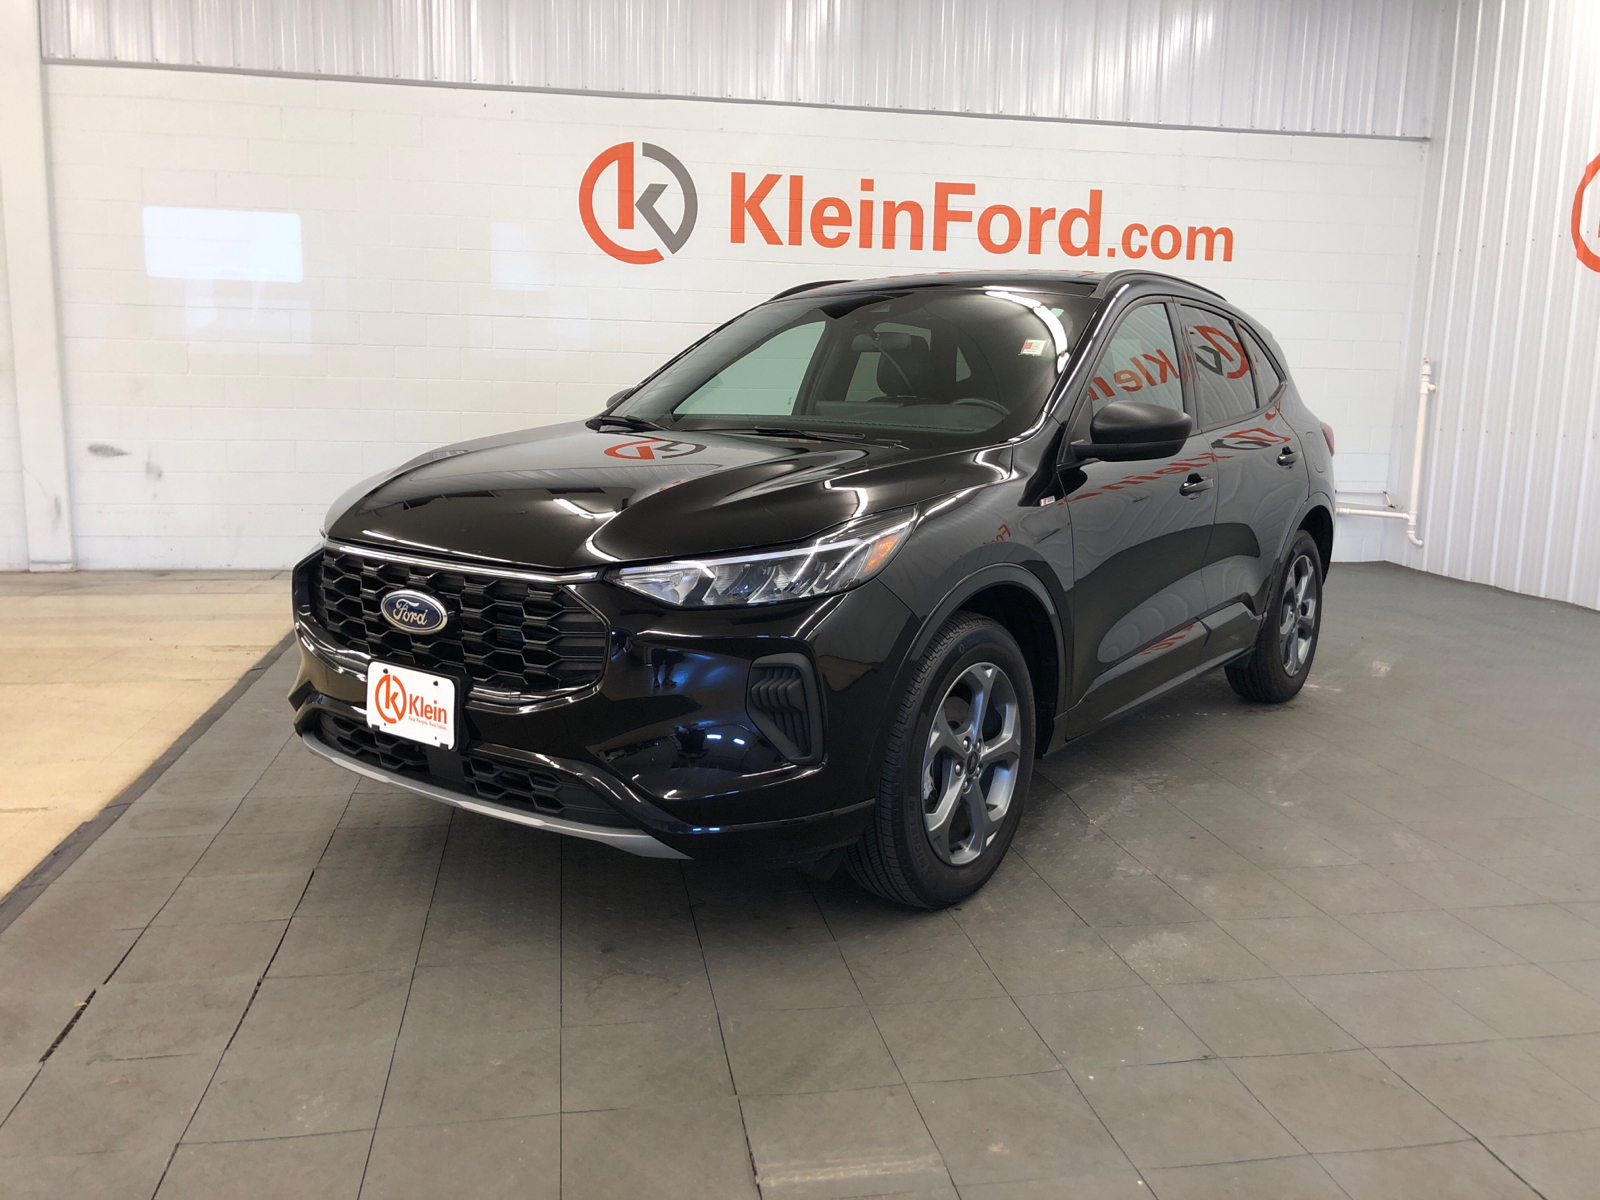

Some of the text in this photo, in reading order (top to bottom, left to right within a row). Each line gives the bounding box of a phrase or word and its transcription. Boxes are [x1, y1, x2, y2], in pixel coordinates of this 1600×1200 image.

[730, 172, 1234, 262] KleinFord.com
[393, 599, 428, 625] Ford
[409, 694, 447, 724] Klein
